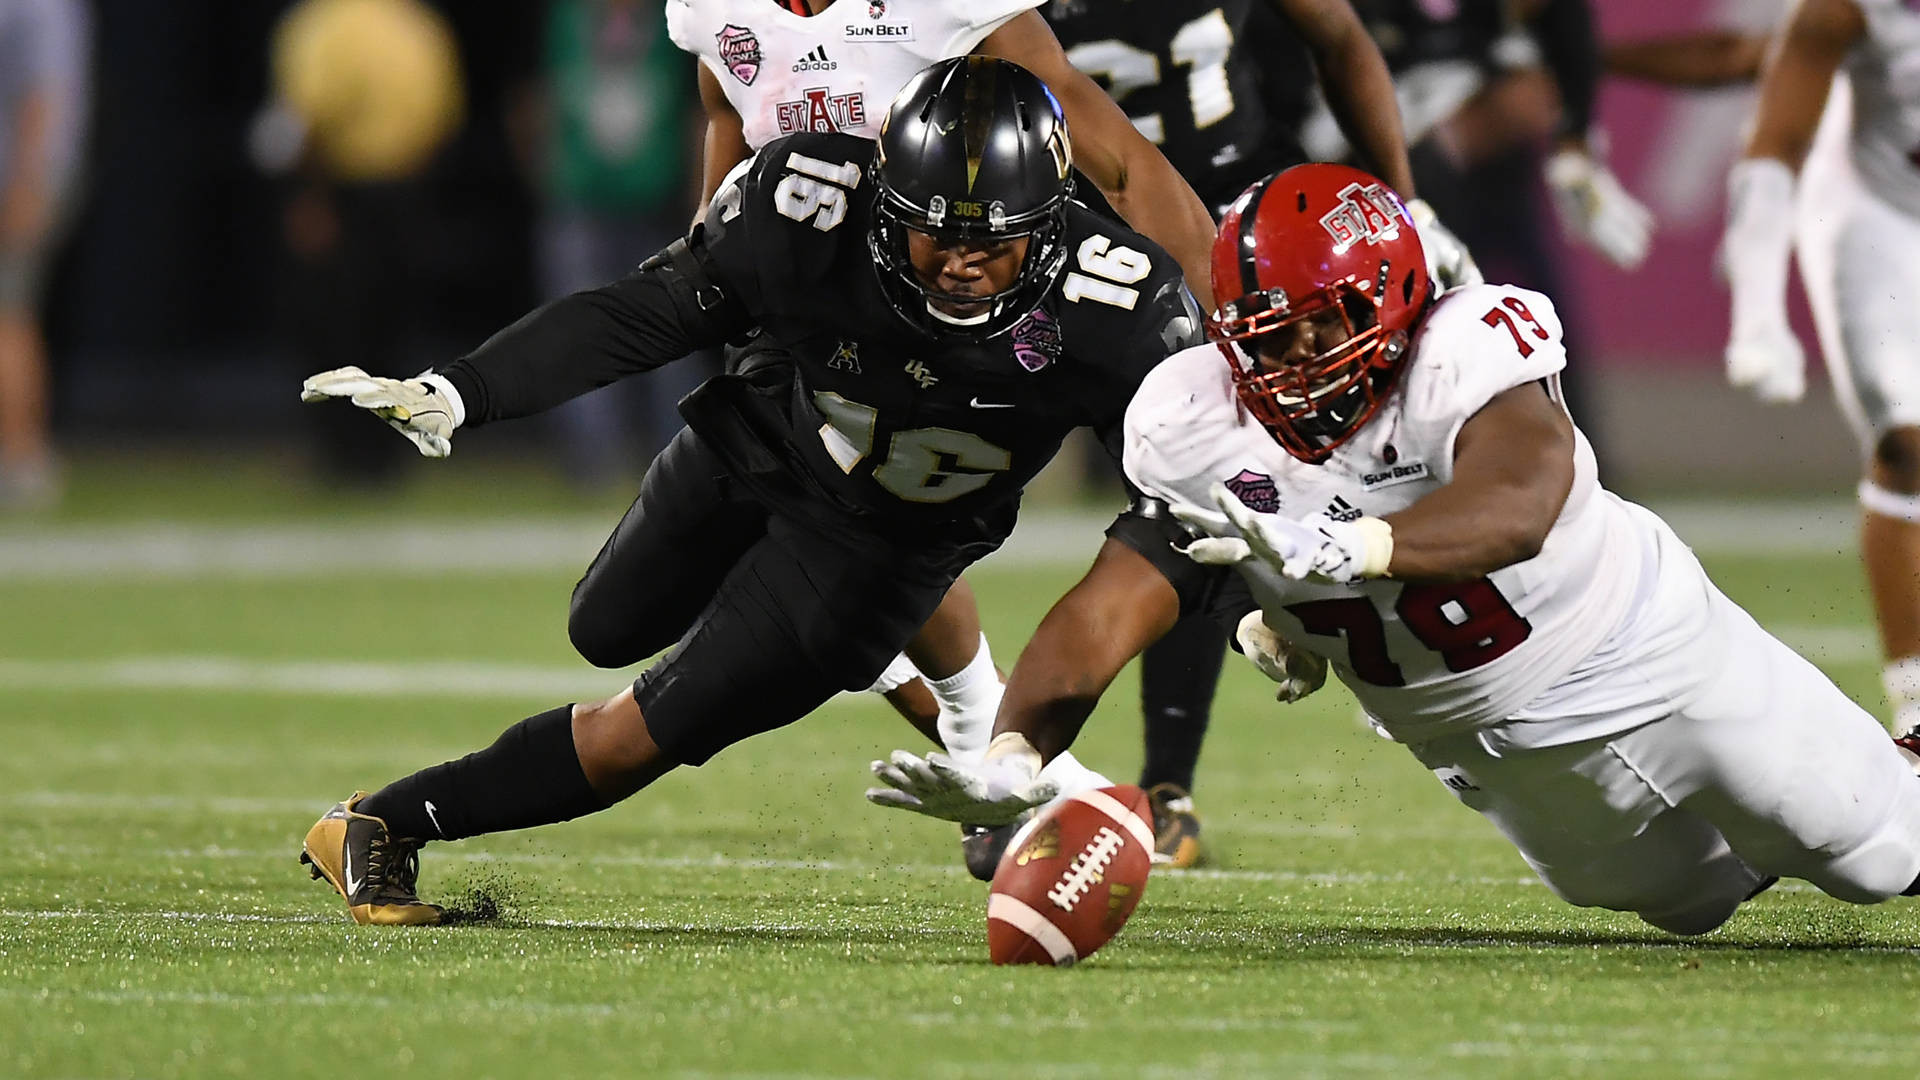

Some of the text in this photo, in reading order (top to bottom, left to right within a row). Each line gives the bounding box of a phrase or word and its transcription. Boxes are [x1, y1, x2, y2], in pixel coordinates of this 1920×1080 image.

[720, 37, 757, 58] Cure
[845, 24, 909, 36] SUN BELT
[792, 60, 838, 73] adidas
[1066, 7, 1235, 144] 21
[776, 86, 866, 135] STATE
[774, 152, 862, 232] 16
[953, 201, 983, 217] 305
[1063, 233, 1152, 311] 16
[1480, 296, 1549, 360] 79
[904, 359, 939, 389] UCF
[813, 390, 1011, 502] 16
[1392, 463, 1422, 478] BELT
